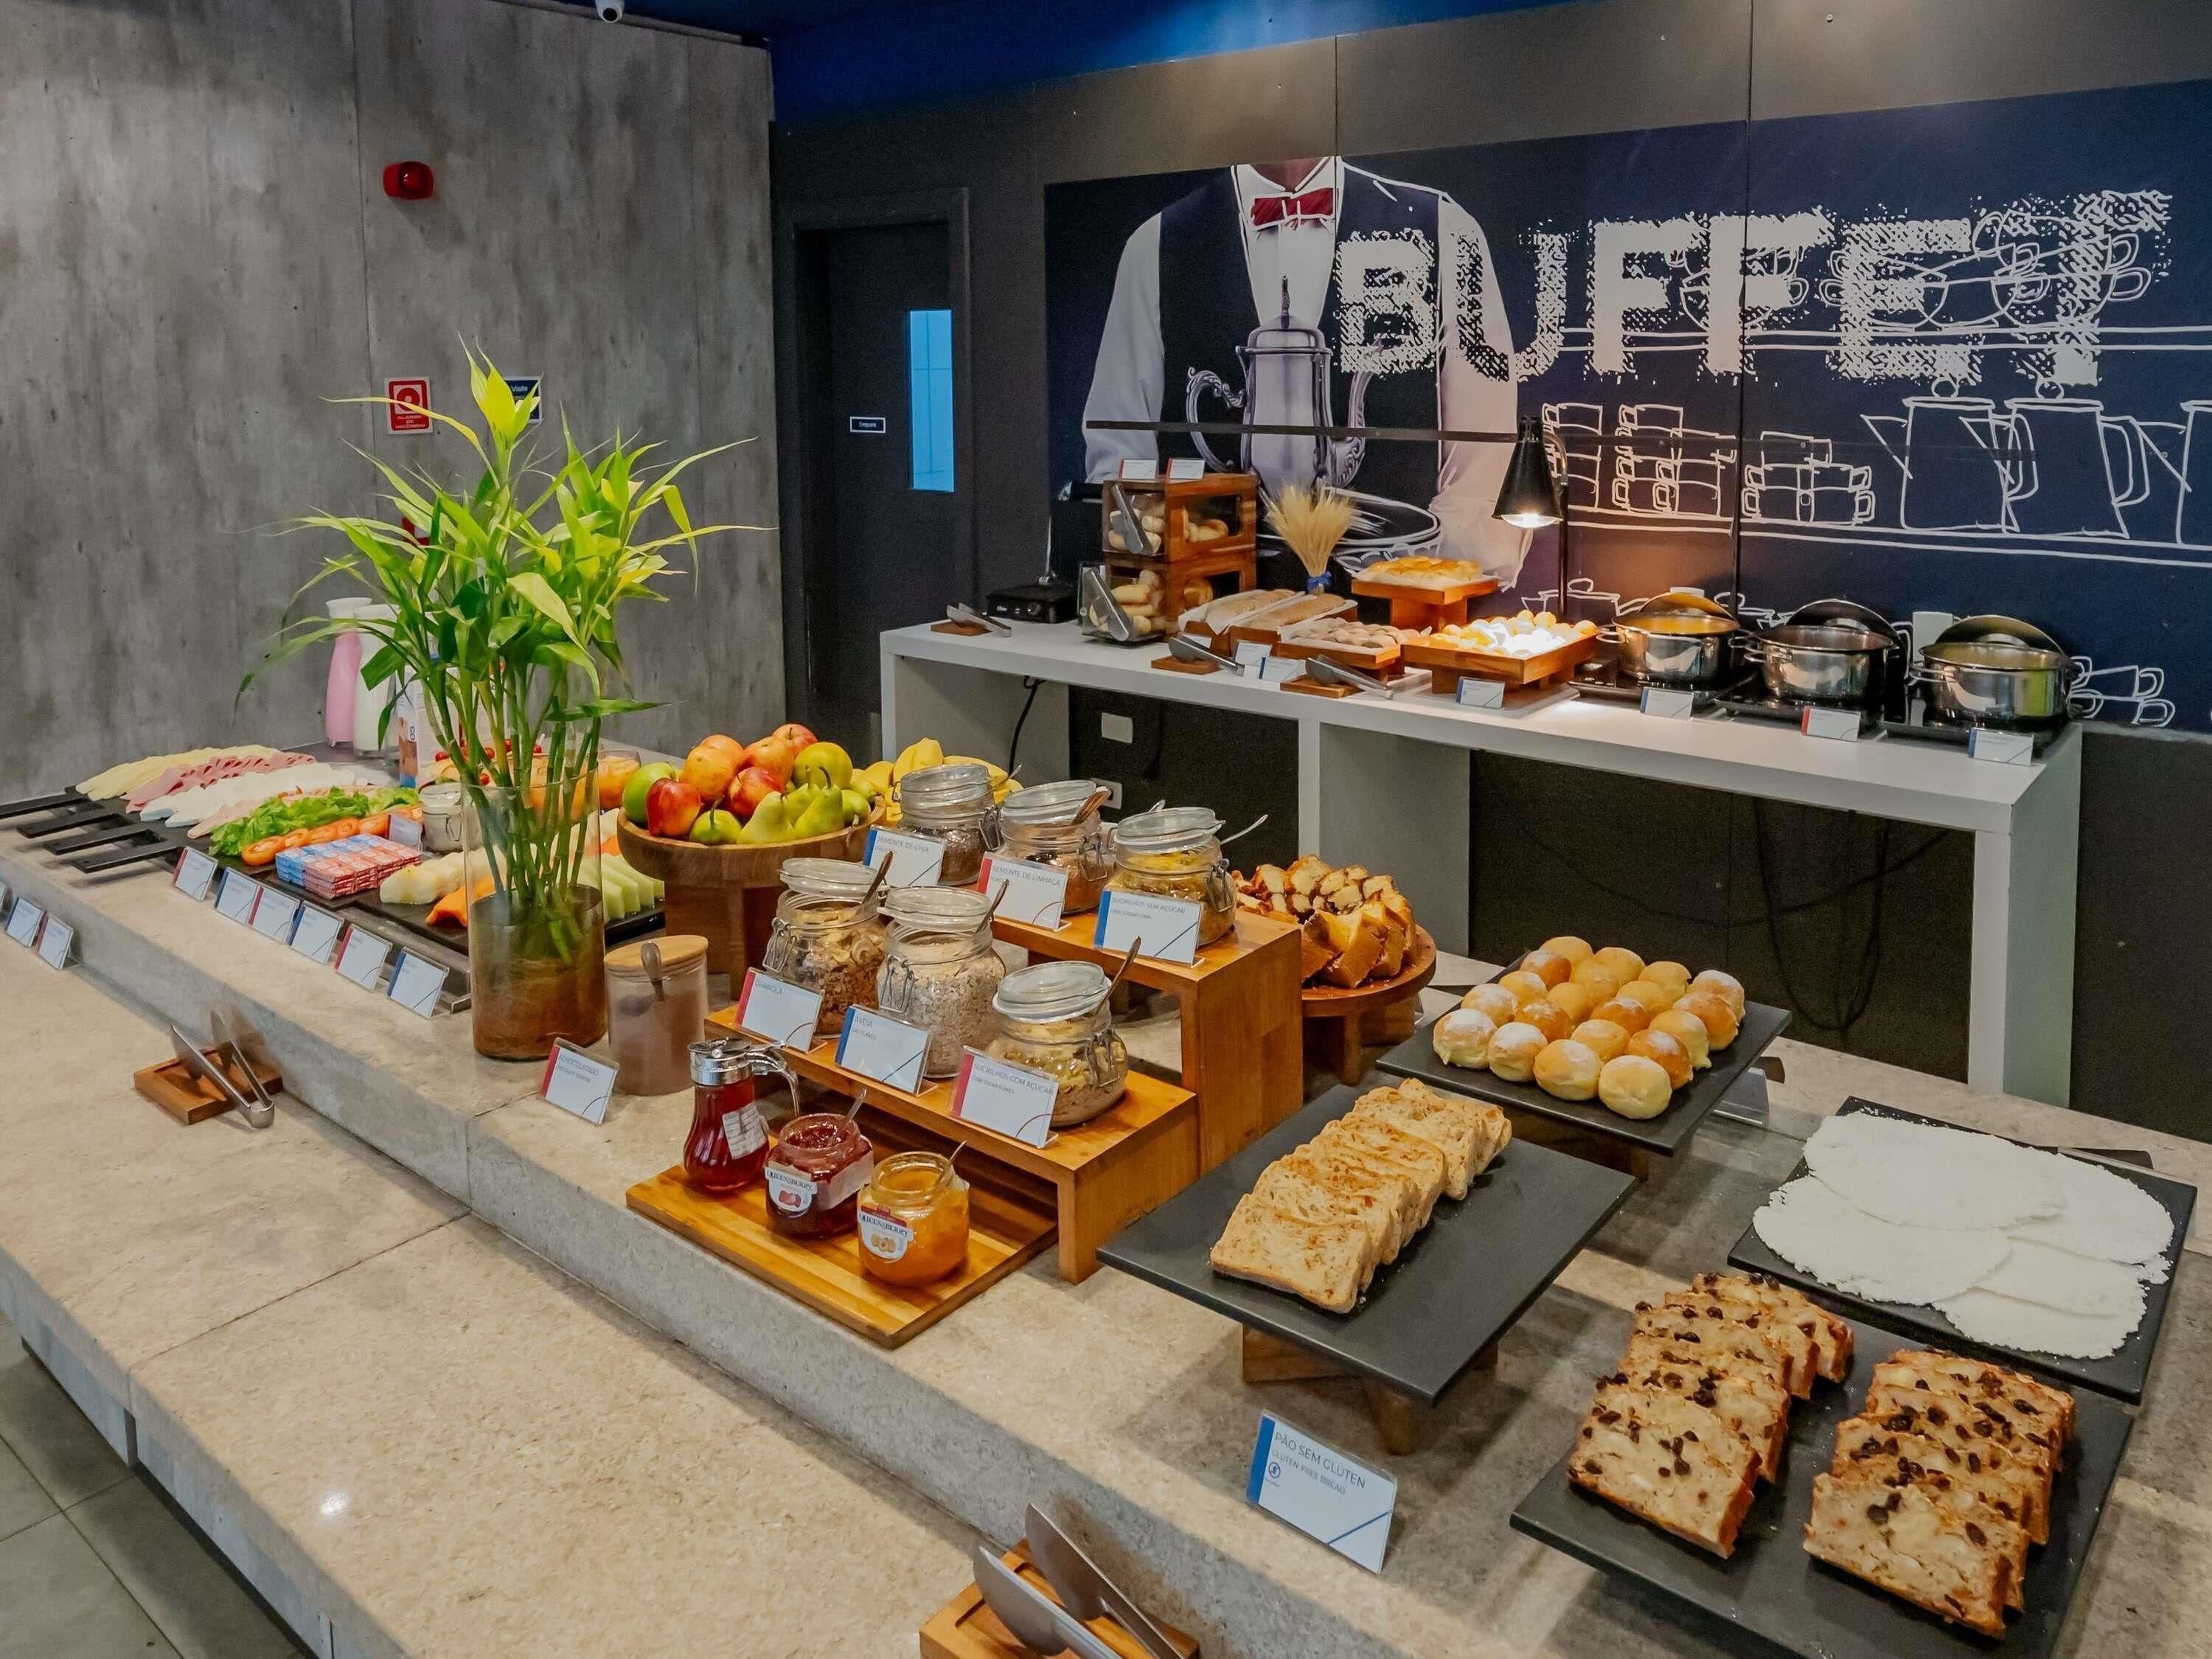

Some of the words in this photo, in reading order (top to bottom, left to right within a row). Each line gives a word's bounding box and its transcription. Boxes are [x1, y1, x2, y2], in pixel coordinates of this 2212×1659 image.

[1335, 190, 2172, 386] BUFFET
[1022, 872, 1032, 880] DE
[766, 1169, 813, 1190] QUEENSBERRY
[859, 1214, 908, 1238] QUEENSBERRY
[1298, 1444, 1321, 1465] SEM
